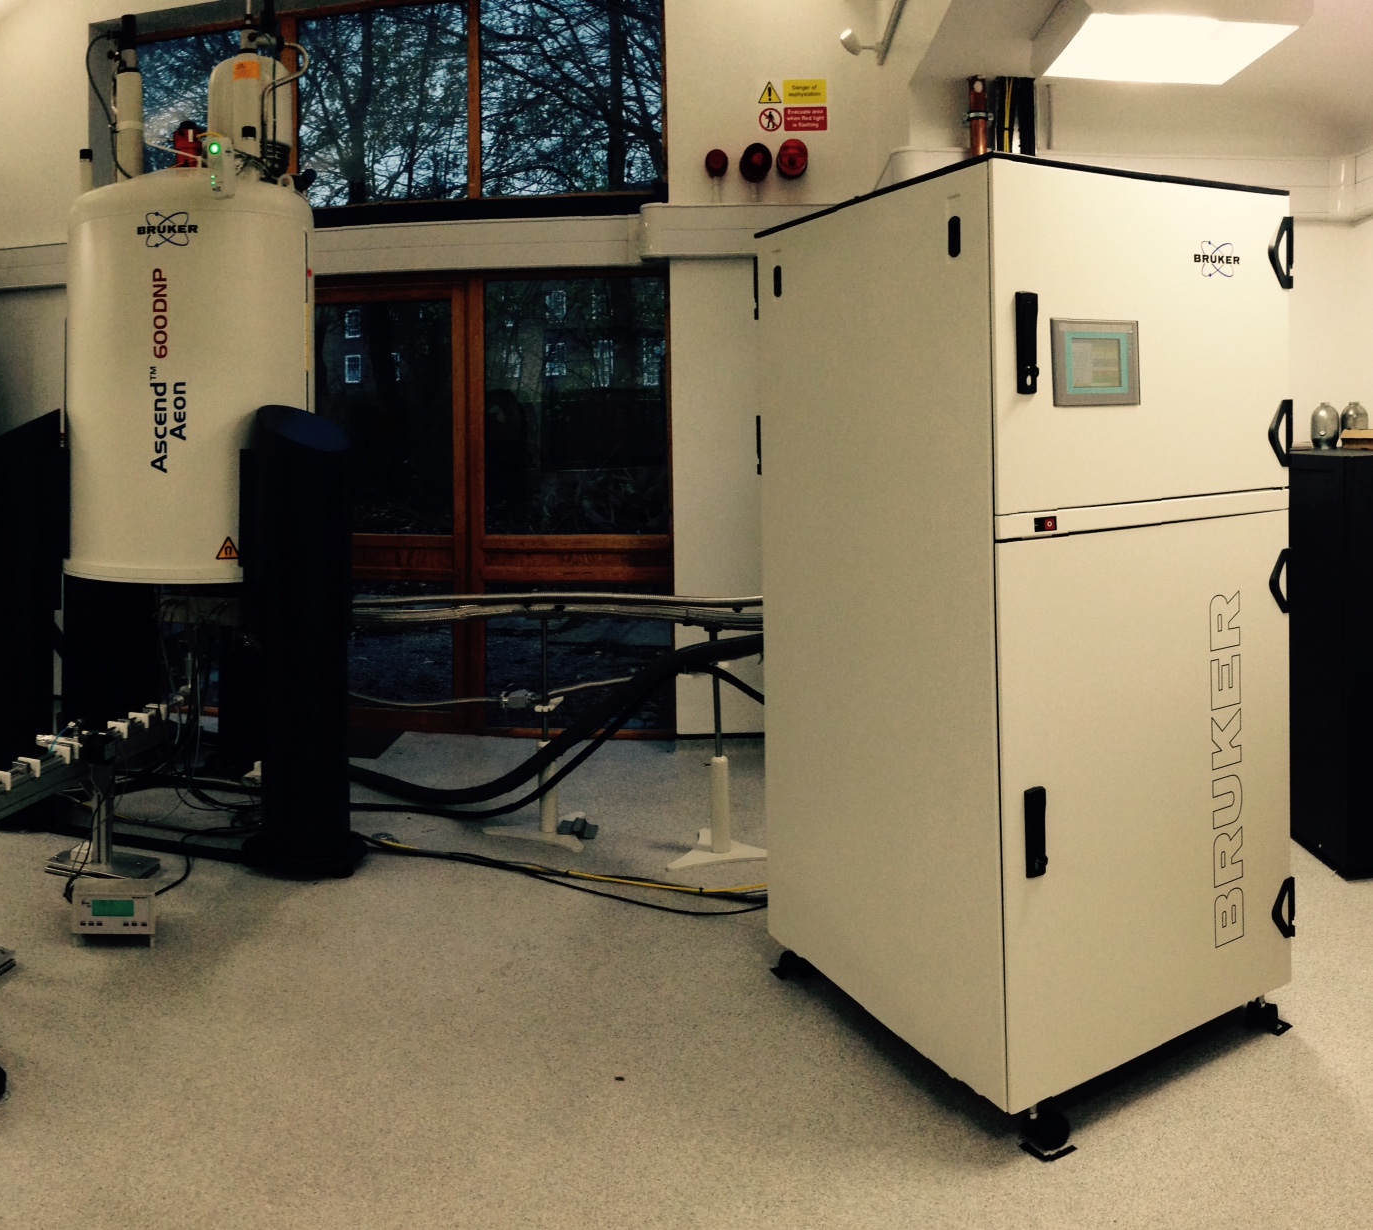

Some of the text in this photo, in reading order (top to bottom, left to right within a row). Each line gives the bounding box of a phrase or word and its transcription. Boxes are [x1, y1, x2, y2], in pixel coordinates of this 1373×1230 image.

[137, 224, 198, 235] BRUKER
[1193, 253, 1241, 265] BRUKER
[152, 268, 168, 359] 600DNP
[169, 381, 187, 441] Aeon
[1209, 590, 1245, 948] BRUKER
